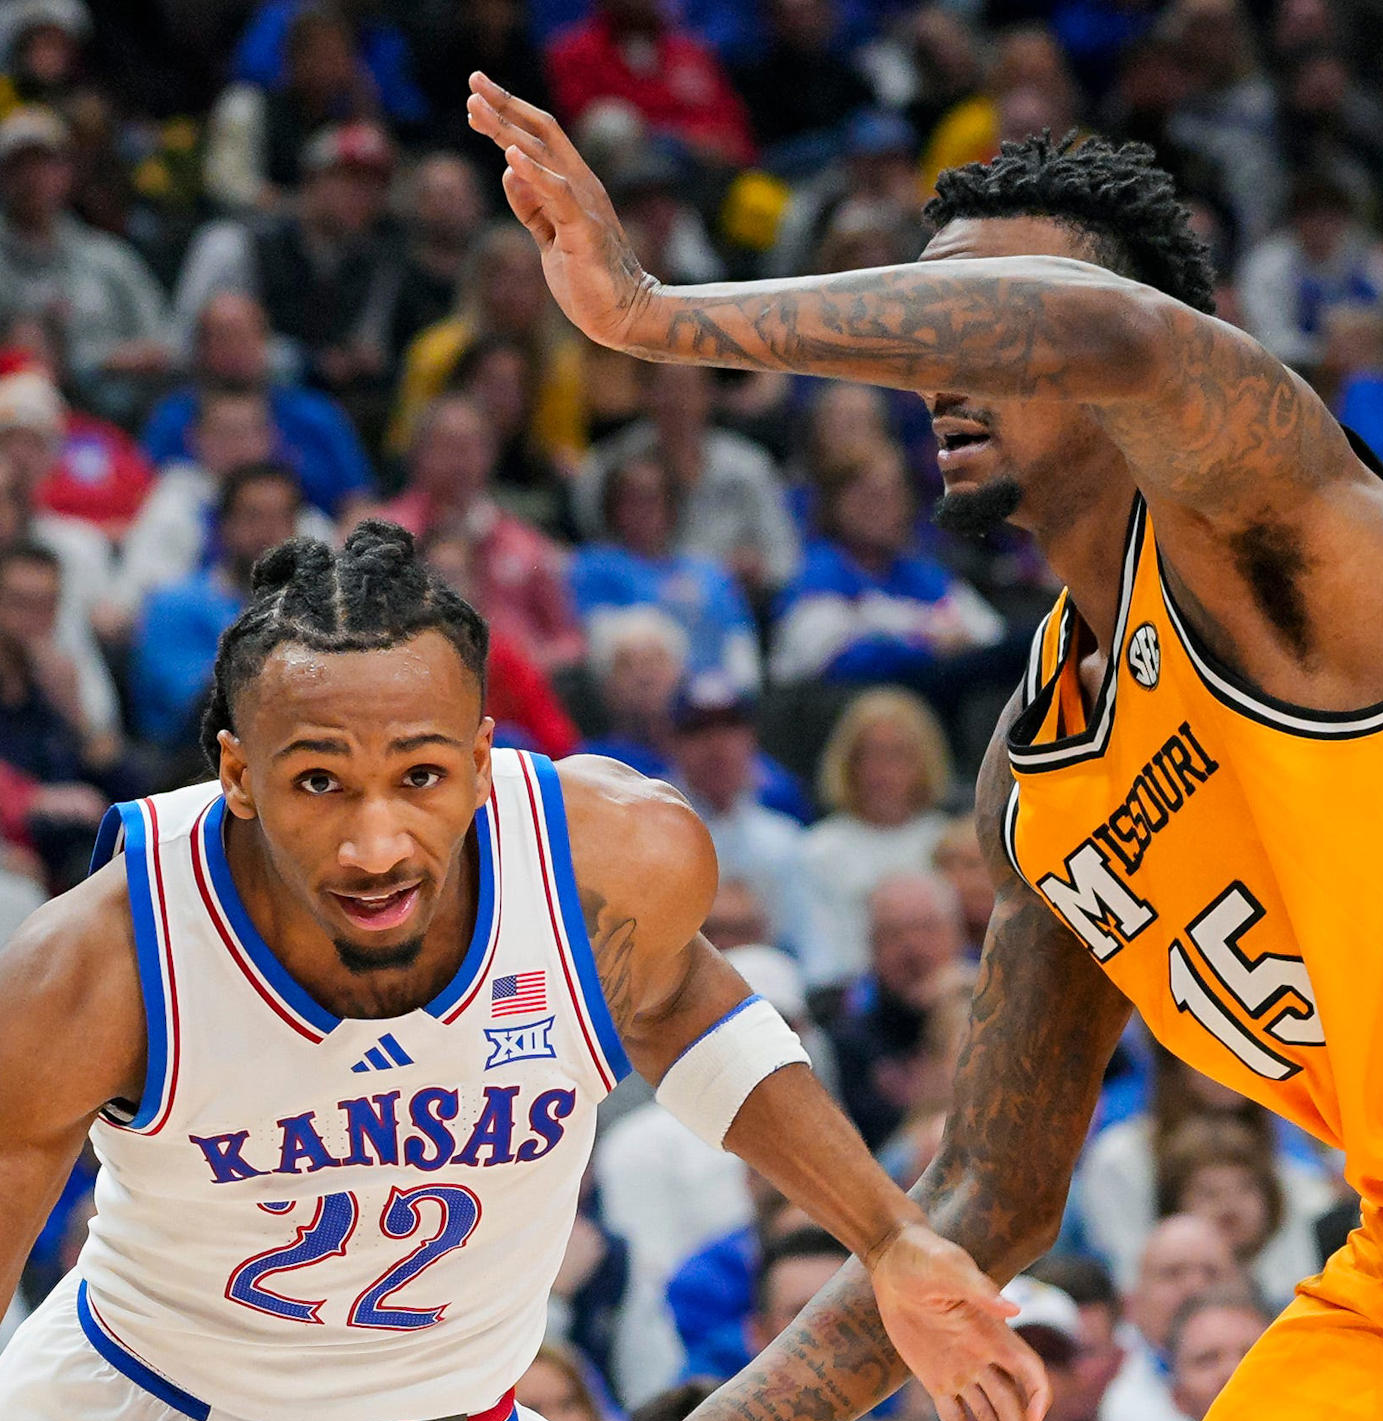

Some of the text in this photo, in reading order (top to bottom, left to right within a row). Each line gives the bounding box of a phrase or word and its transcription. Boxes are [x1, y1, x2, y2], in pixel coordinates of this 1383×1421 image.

[1128, 623, 1161, 688] SEC
[1168, 879, 1327, 1082] 15
[483, 1014, 557, 1072] XII
[189, 1085, 577, 1185] KANSAS
[223, 1181, 483, 1332] 22
